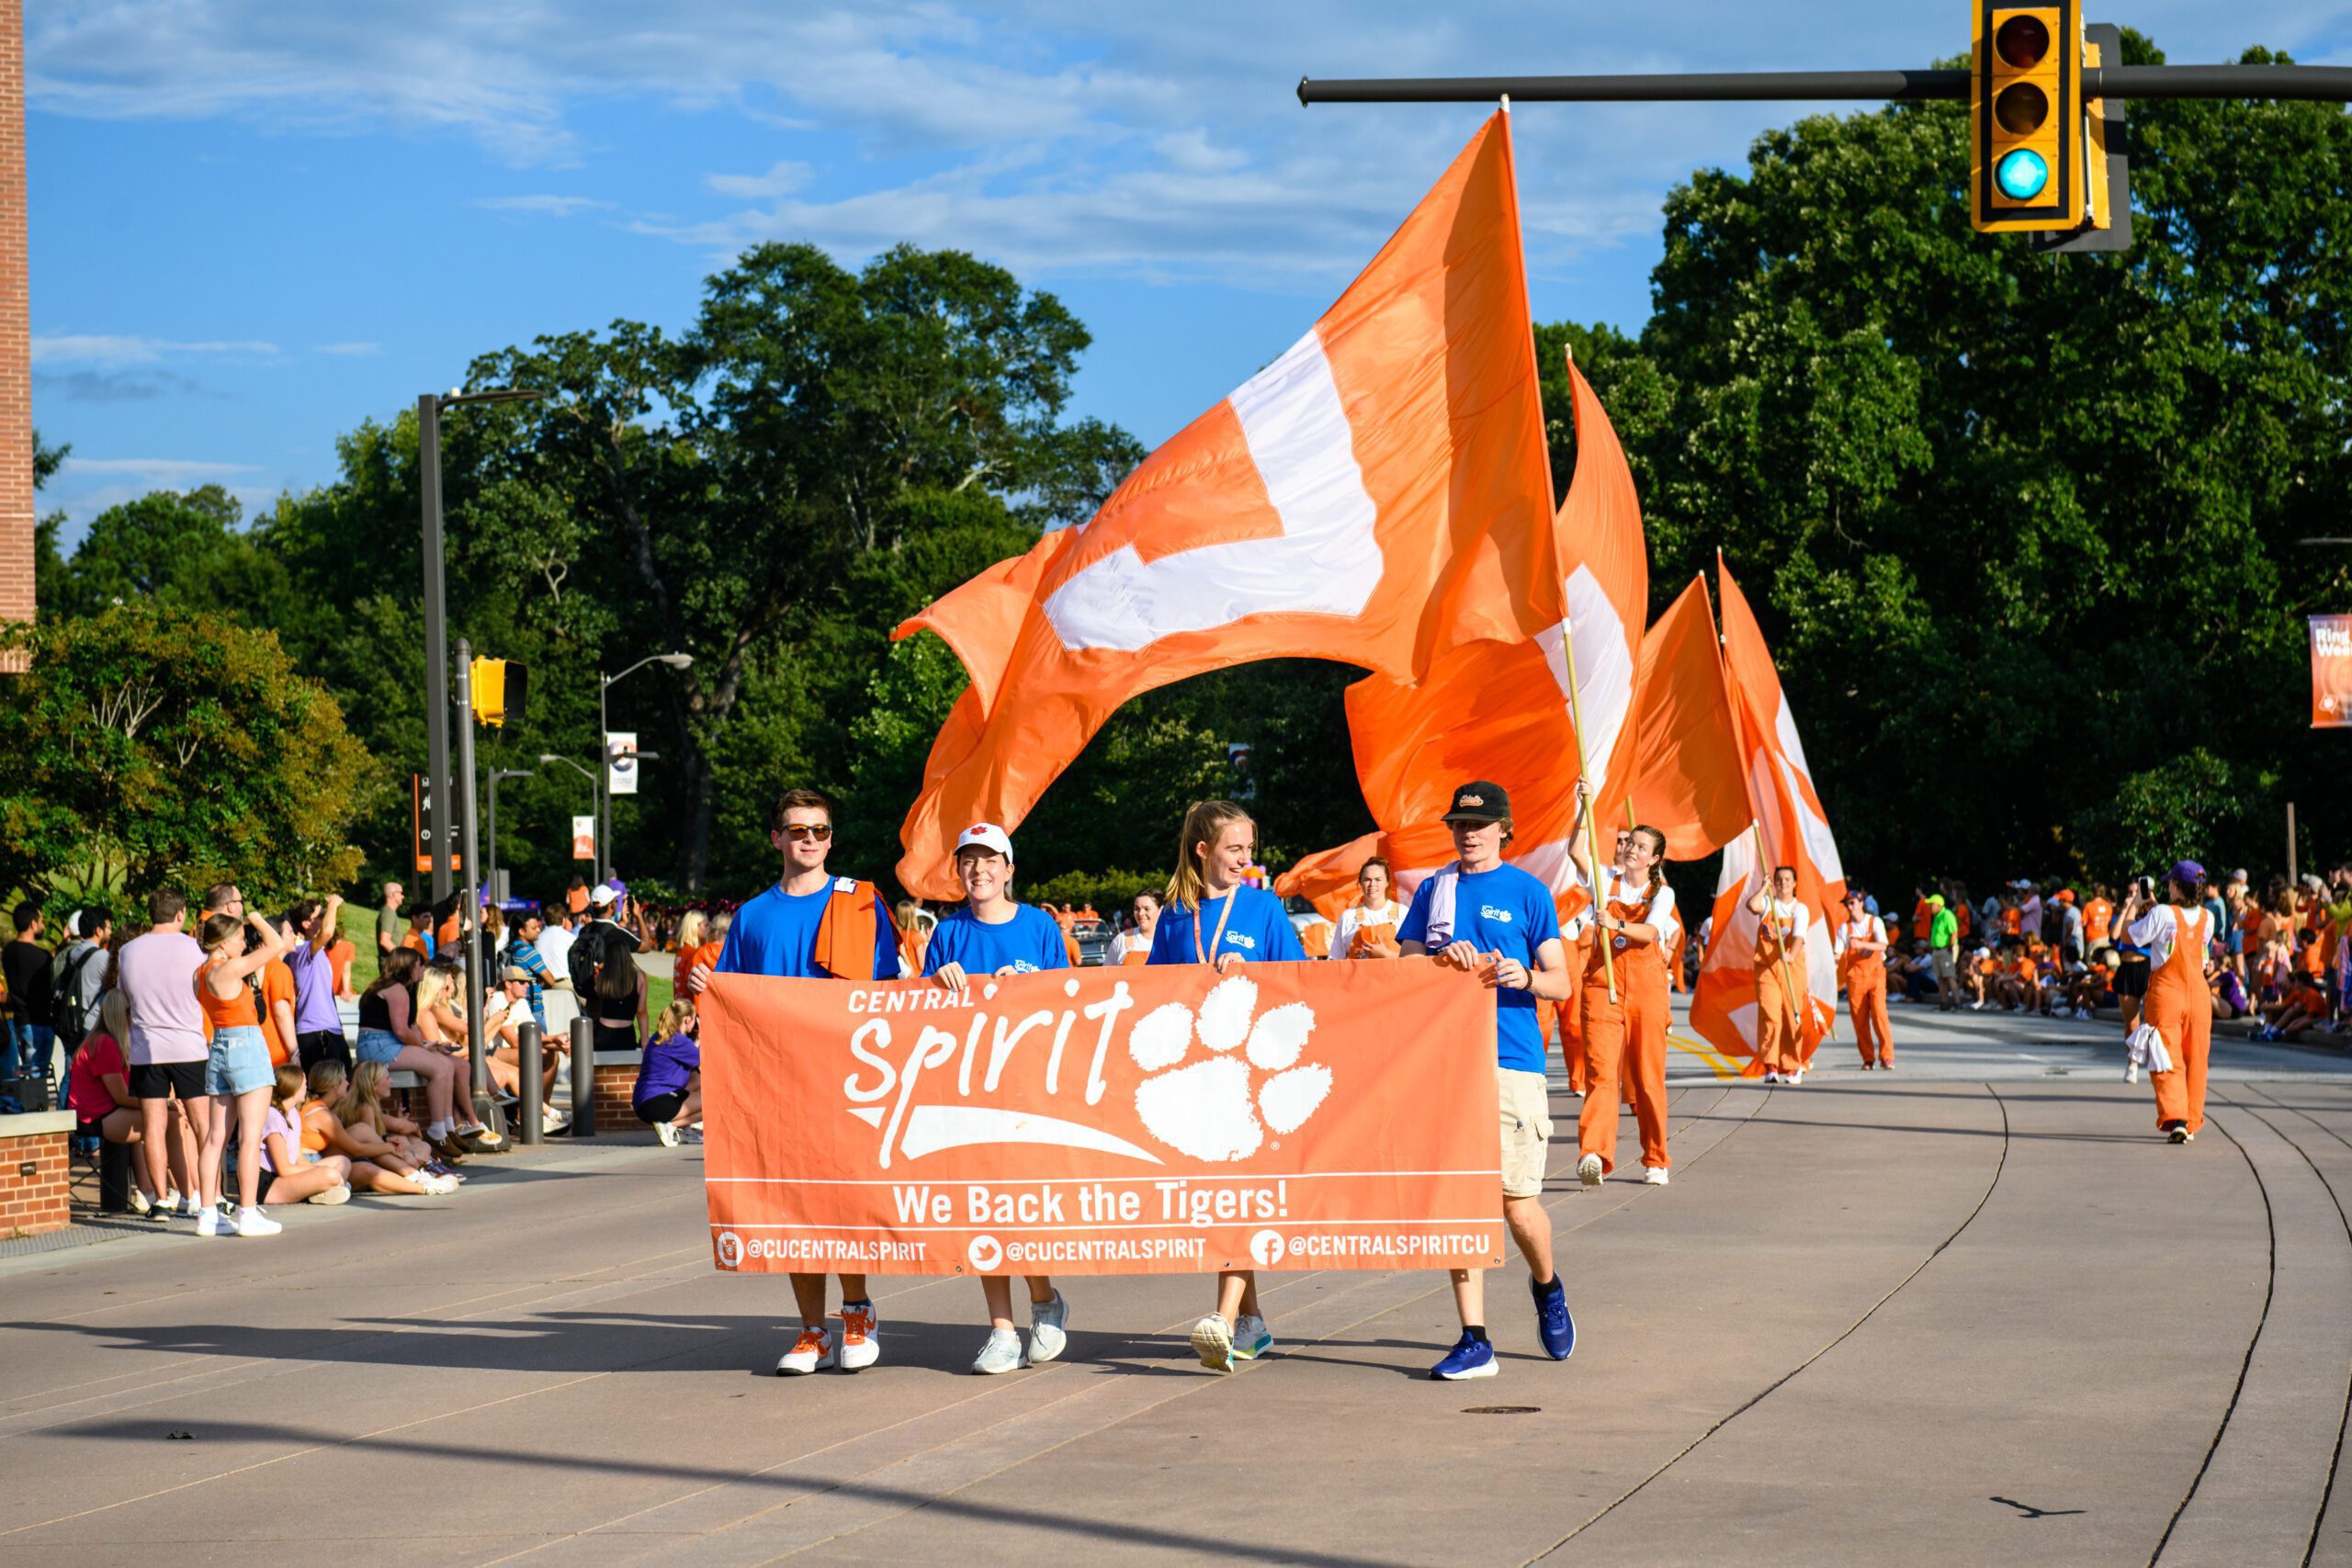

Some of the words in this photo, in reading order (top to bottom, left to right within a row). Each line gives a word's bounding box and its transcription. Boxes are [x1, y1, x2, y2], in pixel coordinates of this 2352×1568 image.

[2315, 627, 2350, 645] Ring
[2316, 643, 2352, 657] Wee
[848, 987, 975, 1013] CENTRAL
[843, 978, 1135, 1169] Spirit
[893, 1186, 952, 1224] We
[967, 1185, 1065, 1224] Back
[1079, 1184, 1140, 1222] the
[1155, 1179, 1288, 1228] Tigers!
[746, 1238, 927, 1260] @CUCENTRALSPIRIT
[1006, 1238, 1207, 1262] @CUCENTRALSPIRIT
[1288, 1234, 1490, 1256] @CENTRALSPIRITCU
